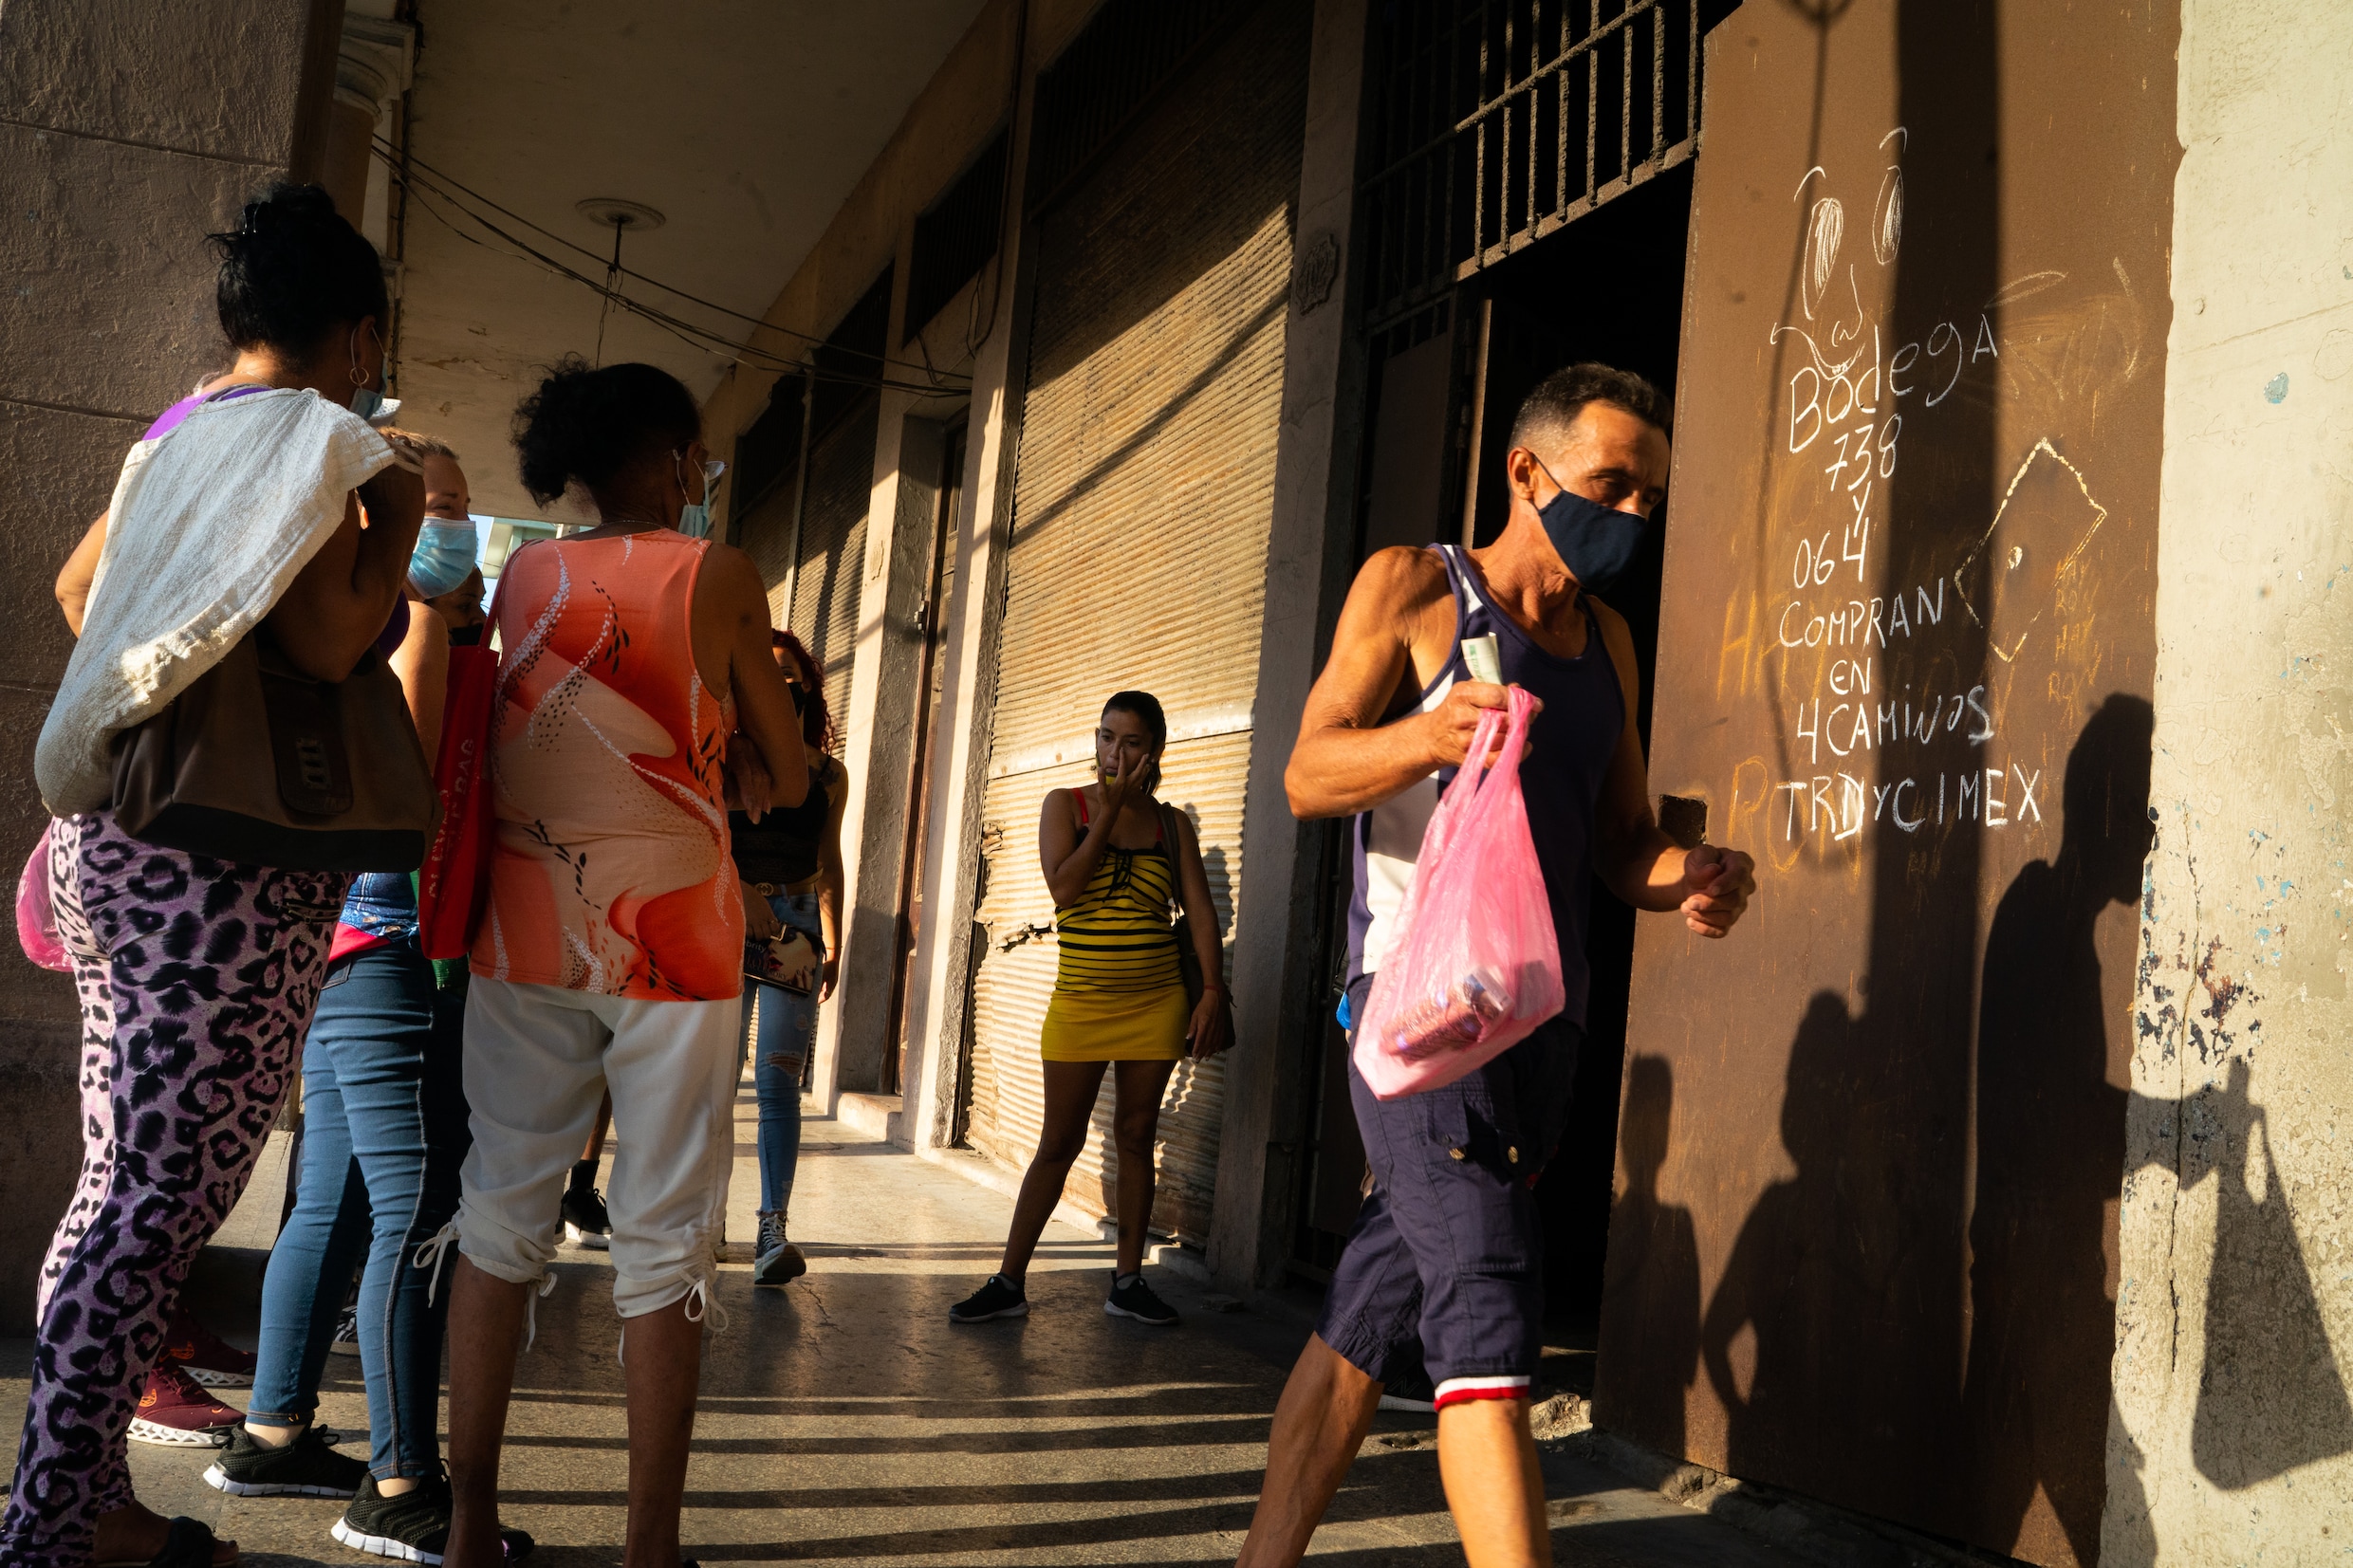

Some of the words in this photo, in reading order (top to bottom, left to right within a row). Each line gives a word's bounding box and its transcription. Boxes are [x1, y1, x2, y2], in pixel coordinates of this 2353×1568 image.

[1825, 414, 1902, 492] 738
[1793, 517, 1869, 589] 064
[1780, 577, 1944, 649] COMPRAN
[1830, 656, 1872, 696] EN
